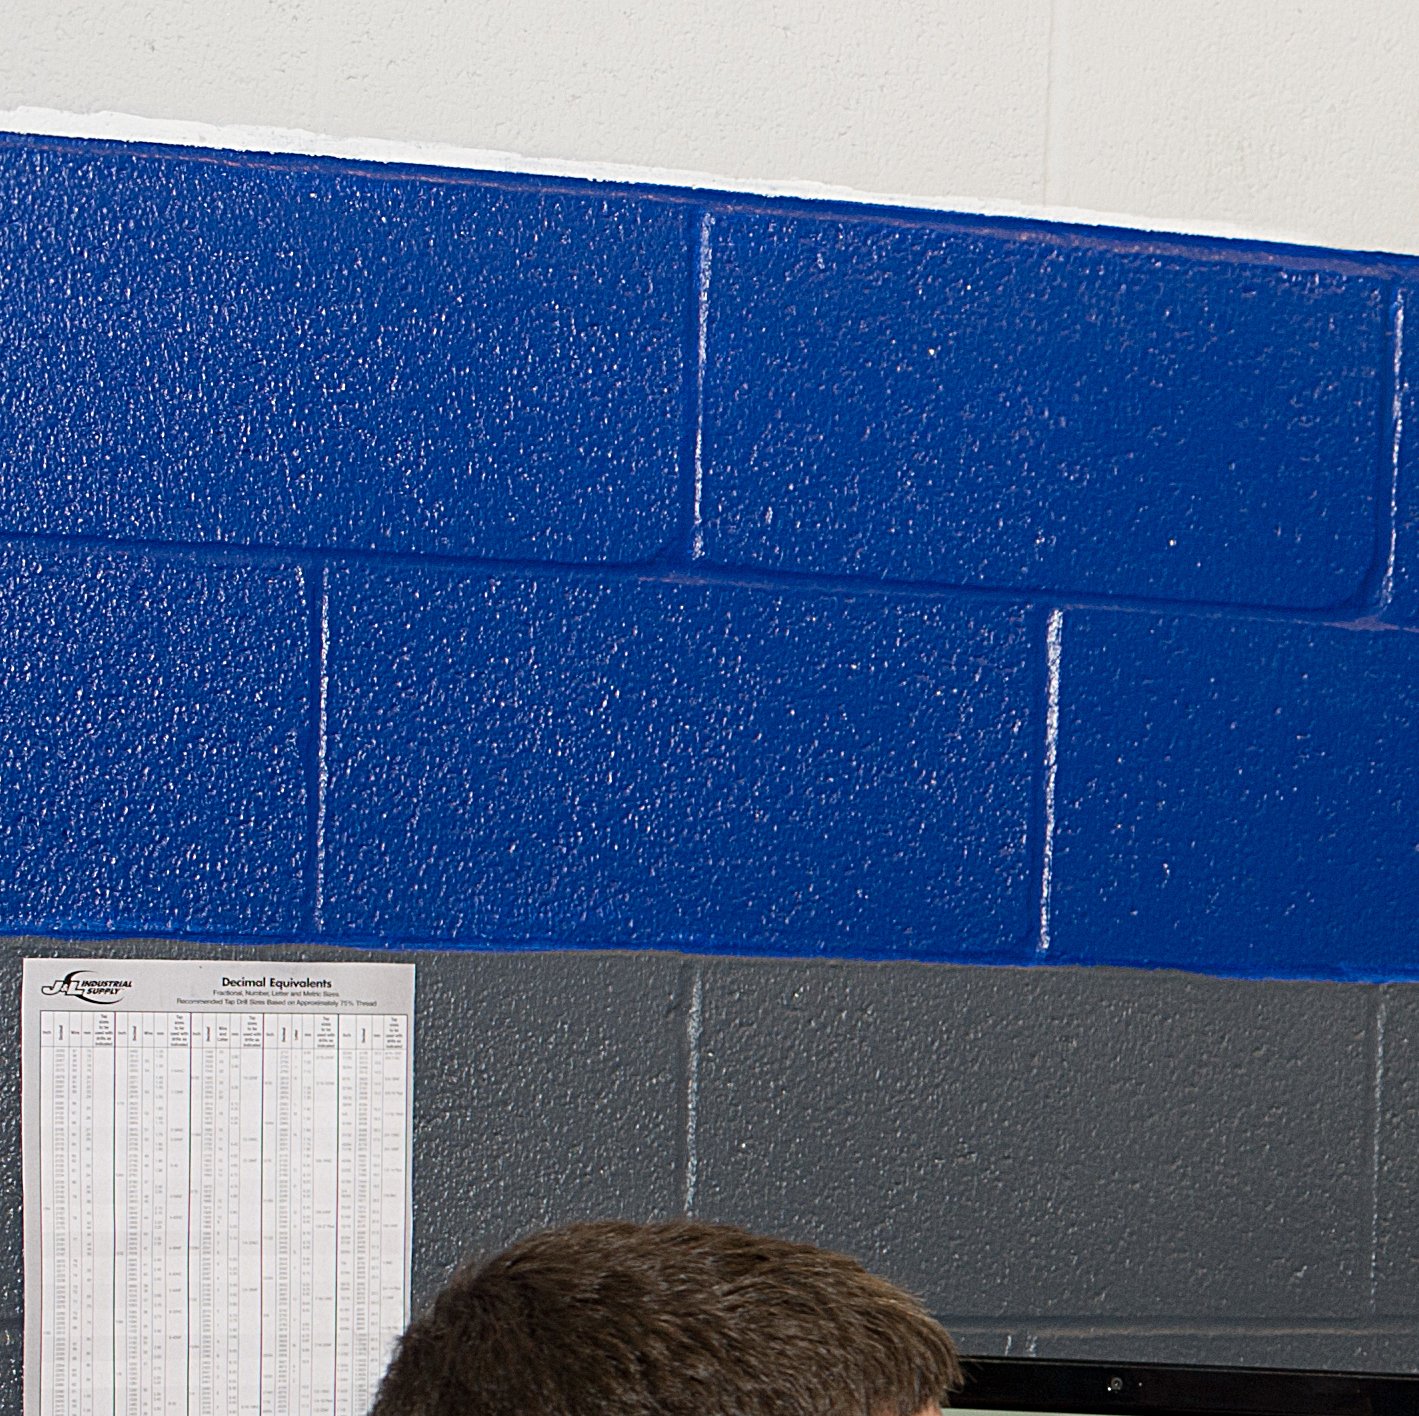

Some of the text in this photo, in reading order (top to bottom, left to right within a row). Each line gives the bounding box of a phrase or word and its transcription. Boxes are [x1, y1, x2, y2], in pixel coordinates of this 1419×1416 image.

[222, 977, 332, 990] Decimal Equivalents
[297, 999, 338, 1007] Approximately
